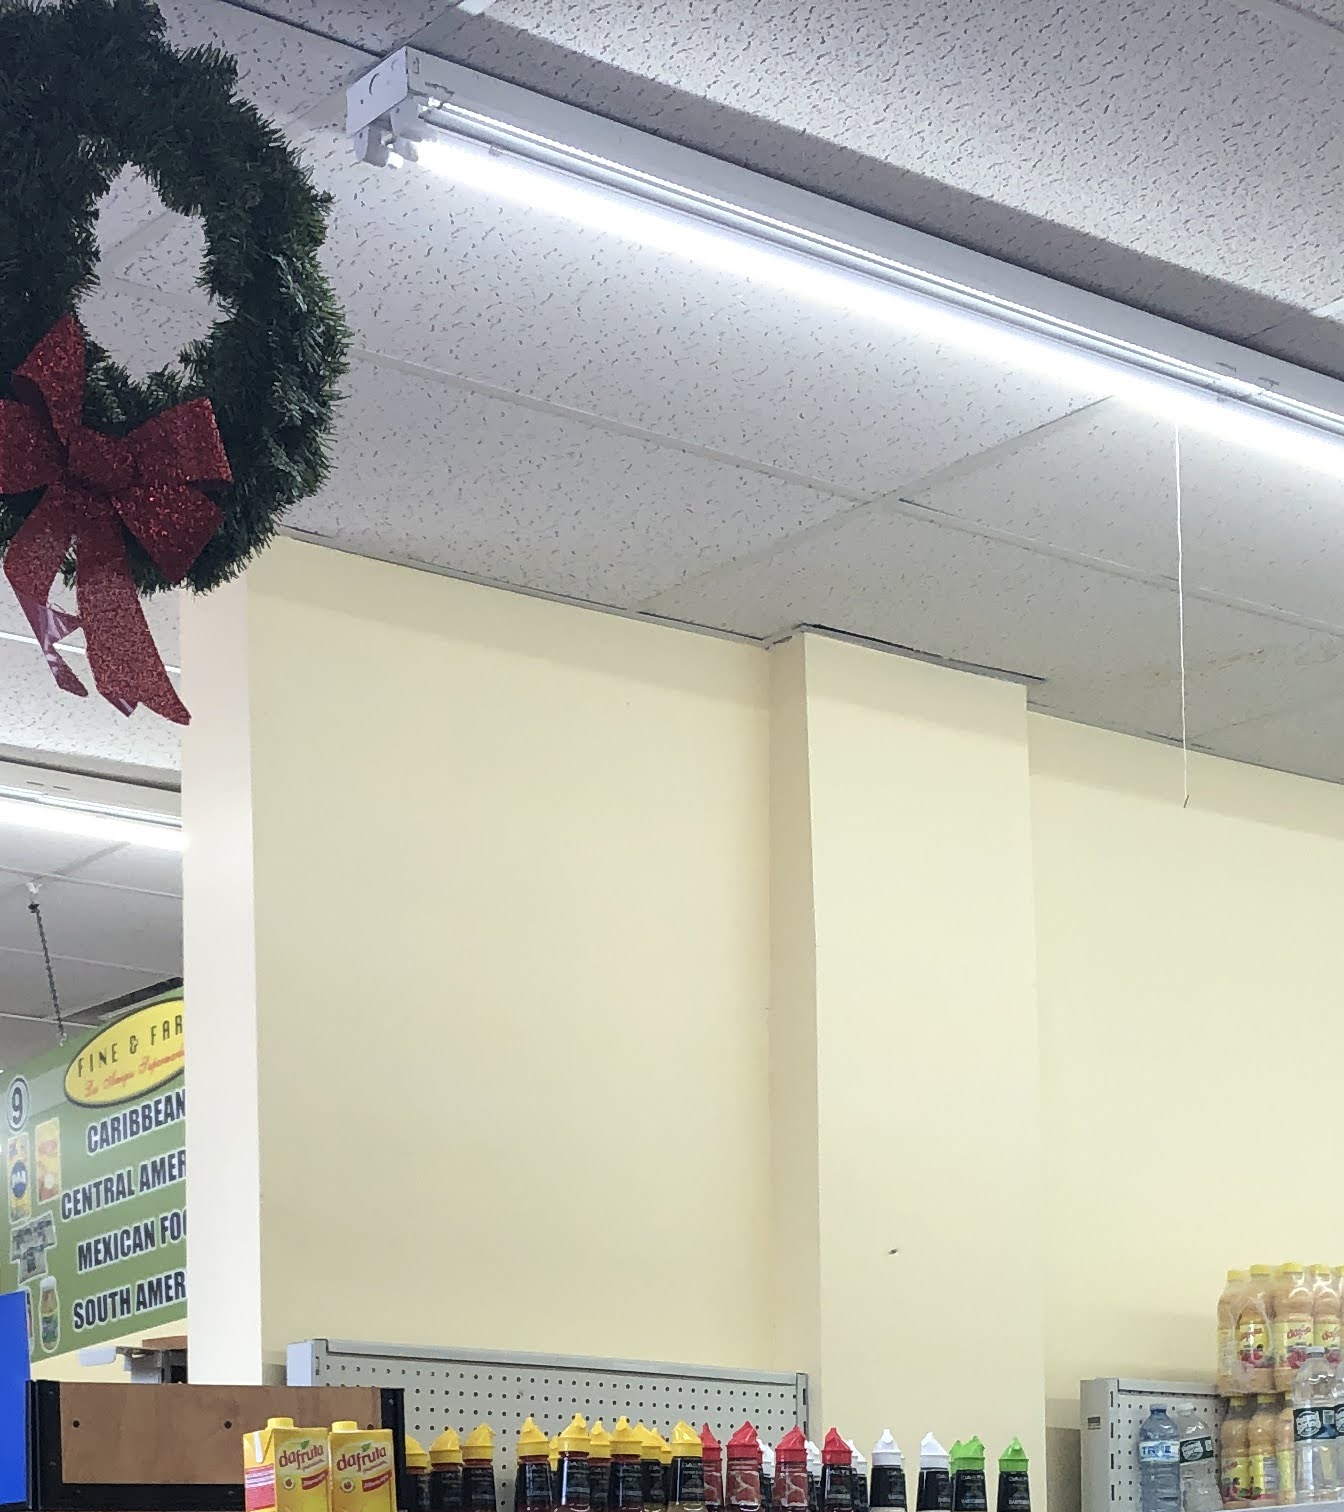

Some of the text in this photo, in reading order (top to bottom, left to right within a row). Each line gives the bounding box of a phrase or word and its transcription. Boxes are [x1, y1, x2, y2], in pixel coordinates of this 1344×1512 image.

[78, 1042, 119, 1078] FINE
[11, 1087, 23, 1119] 9
[87, 1089, 185, 1153] CARIBBEAN
[62, 1171, 136, 1220] CENTRAL
[77, 1225, 155, 1272] MEXICAN
[74, 1295, 131, 1330] SOUTH
[279, 1444, 324, 1469] dafruta
[336, 1447, 386, 1473] dafruta
